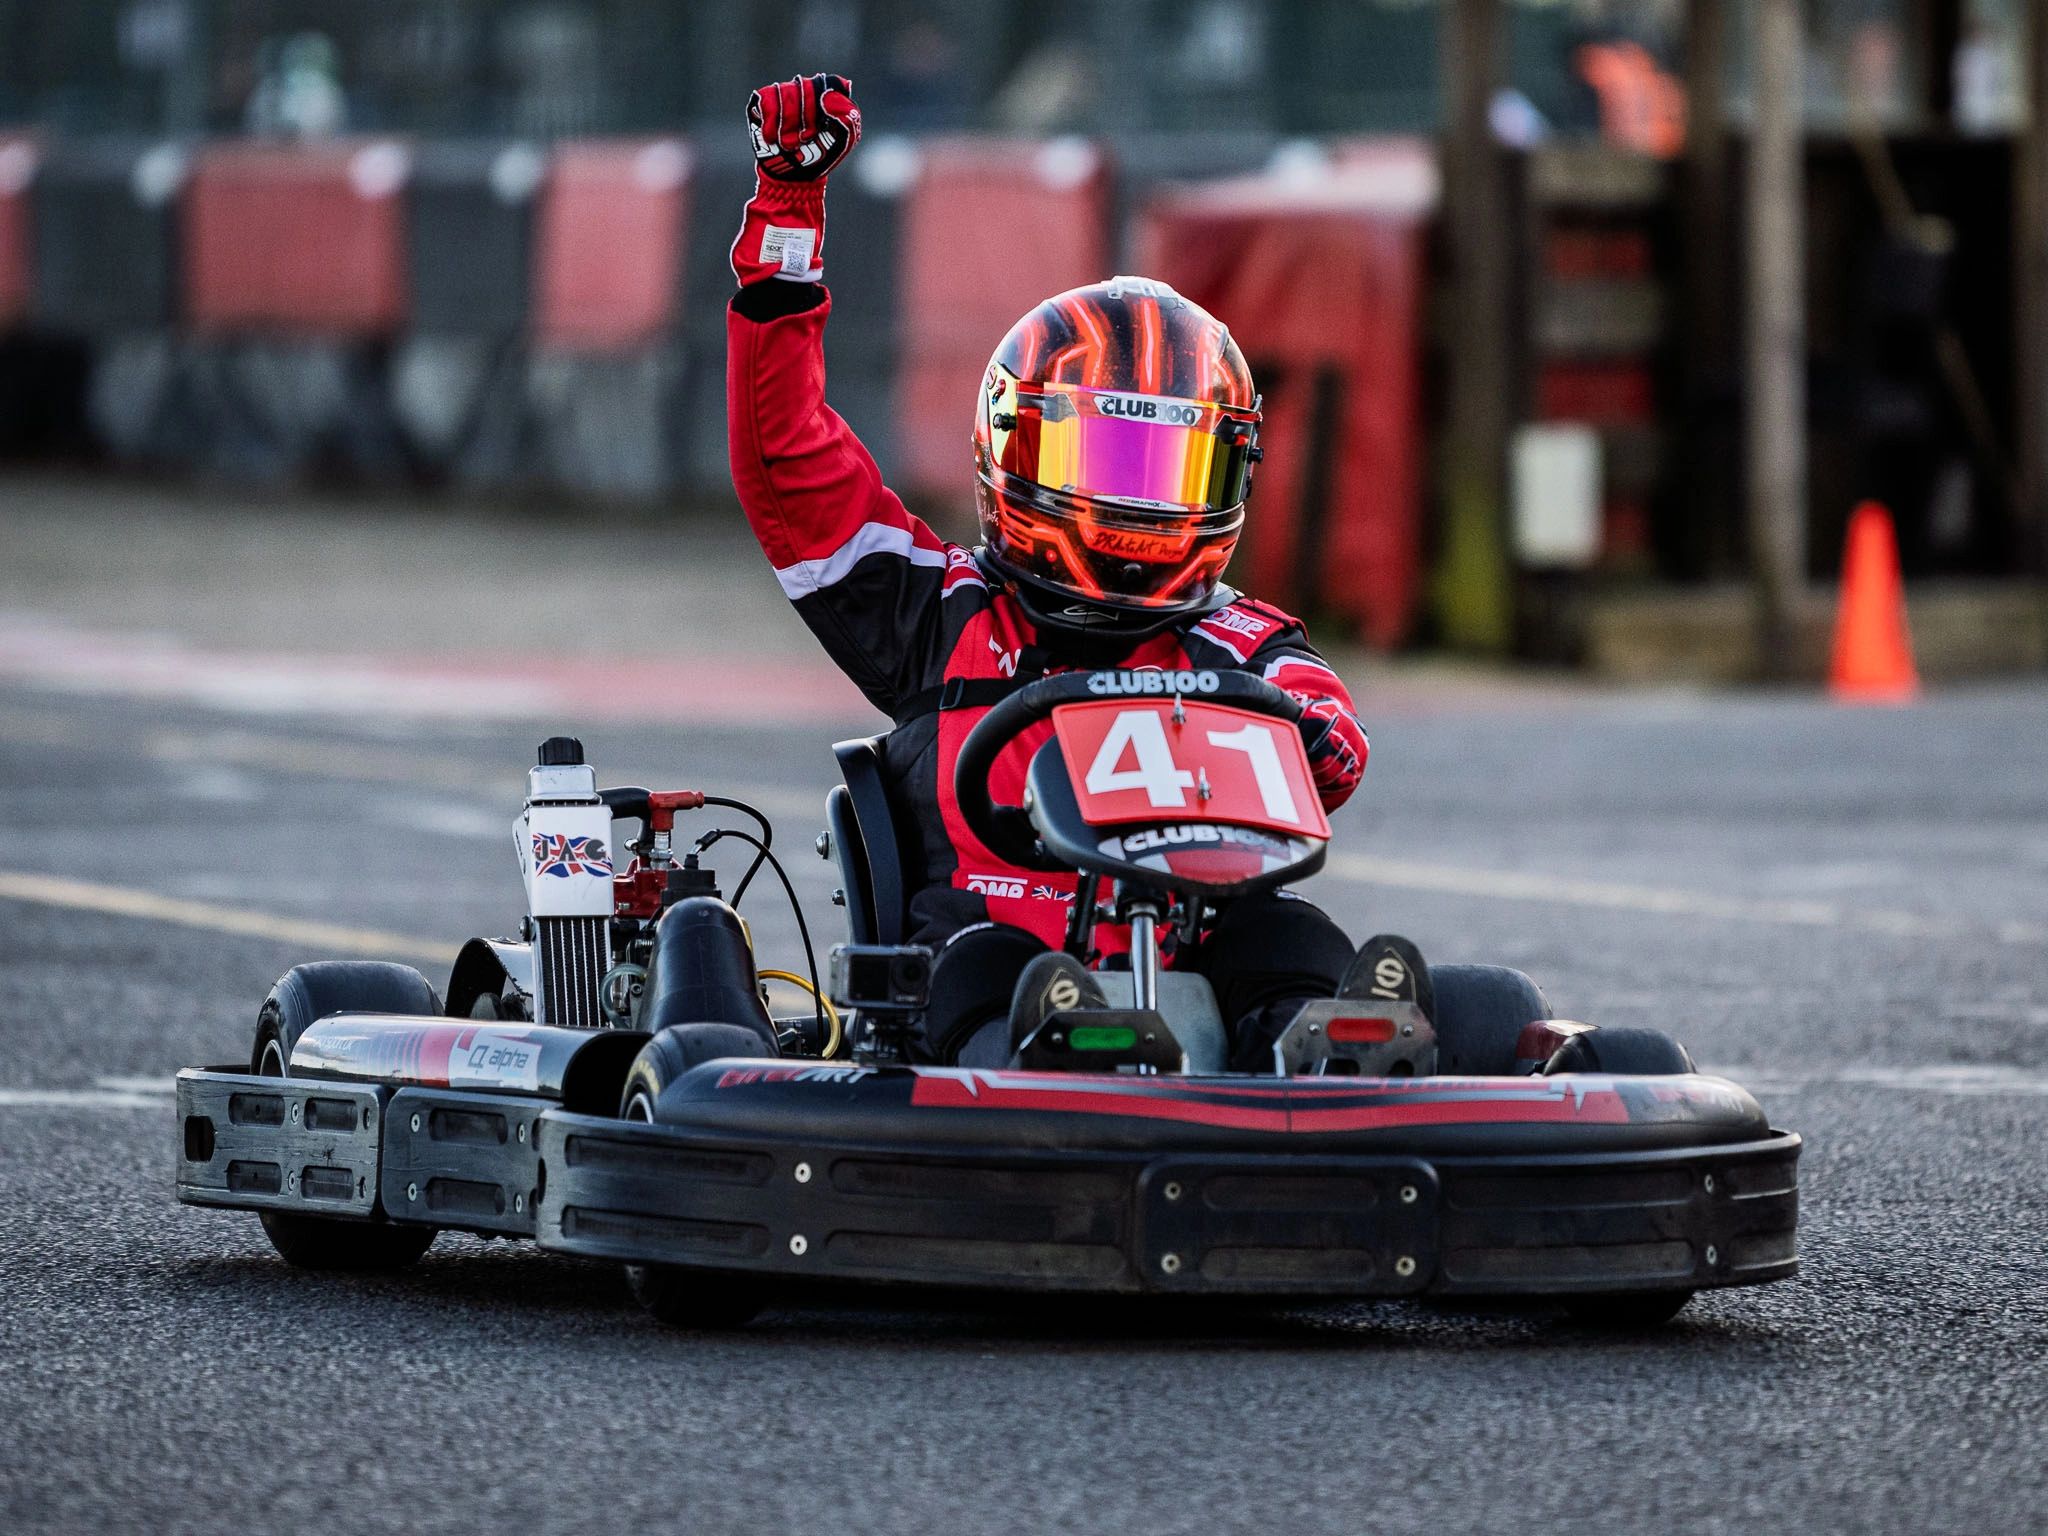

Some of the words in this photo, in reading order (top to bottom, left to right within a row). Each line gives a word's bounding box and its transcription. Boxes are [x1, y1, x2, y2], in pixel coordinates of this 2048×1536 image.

[1101, 397, 1196, 425] CLUB100
[1208, 608, 1265, 634] OMP
[1086, 670, 1220, 695] CLUB100
[1085, 710, 1300, 825] 41
[489, 1047, 529, 1073] alpha
